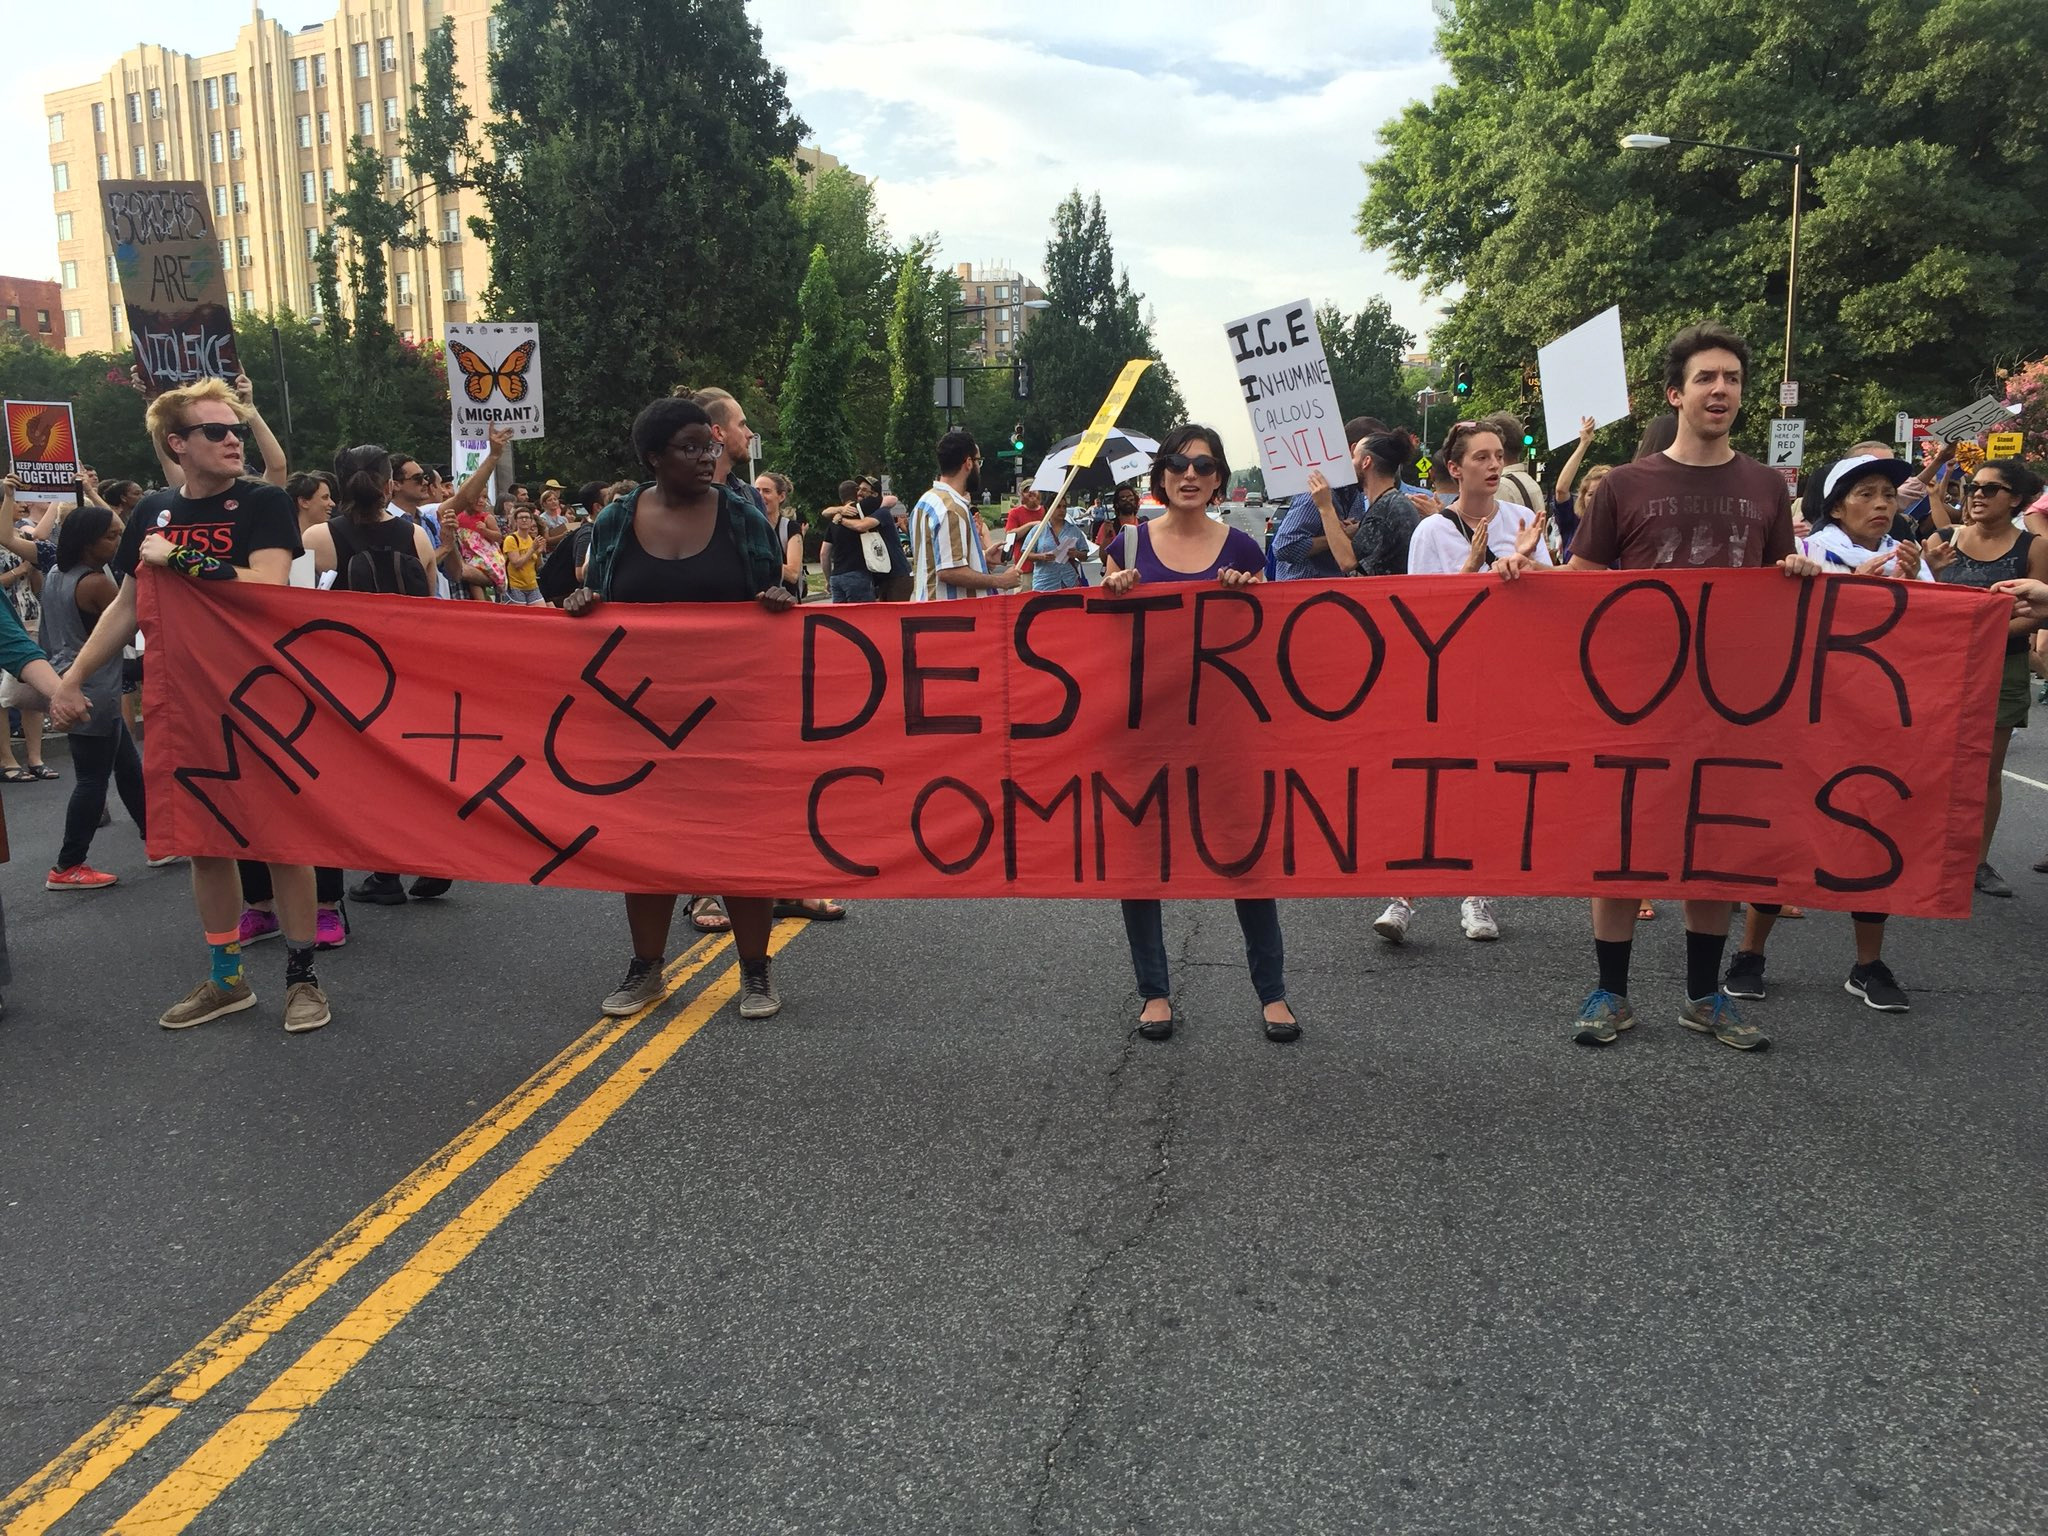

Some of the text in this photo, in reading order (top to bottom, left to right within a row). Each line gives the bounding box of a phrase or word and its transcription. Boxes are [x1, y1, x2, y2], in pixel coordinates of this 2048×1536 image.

[108, 189, 208, 245] BORDERS
[151, 255, 198, 303] ARE
[131, 324, 239, 386] VIOLENCE
[1239, 358, 1332, 404] INHUMANE
[465, 406, 532, 422] MIGRANT
[1253, 398, 1325, 433] CALLOUS
[1776, 423, 1799, 432] STOP
[16, 461, 75, 471] KEEP LOVED ONES
[1263, 427, 1343, 471] EVIL
[1777, 440, 1796, 449] RED
[1641, 496, 1678, 519] LET'S
[801, 576, 1912, 741] DESTROY OUR
[172, 618, 396, 849] MPD
[457, 624, 717, 885] ICE
[807, 754, 1913, 893] COMMUNITIES
